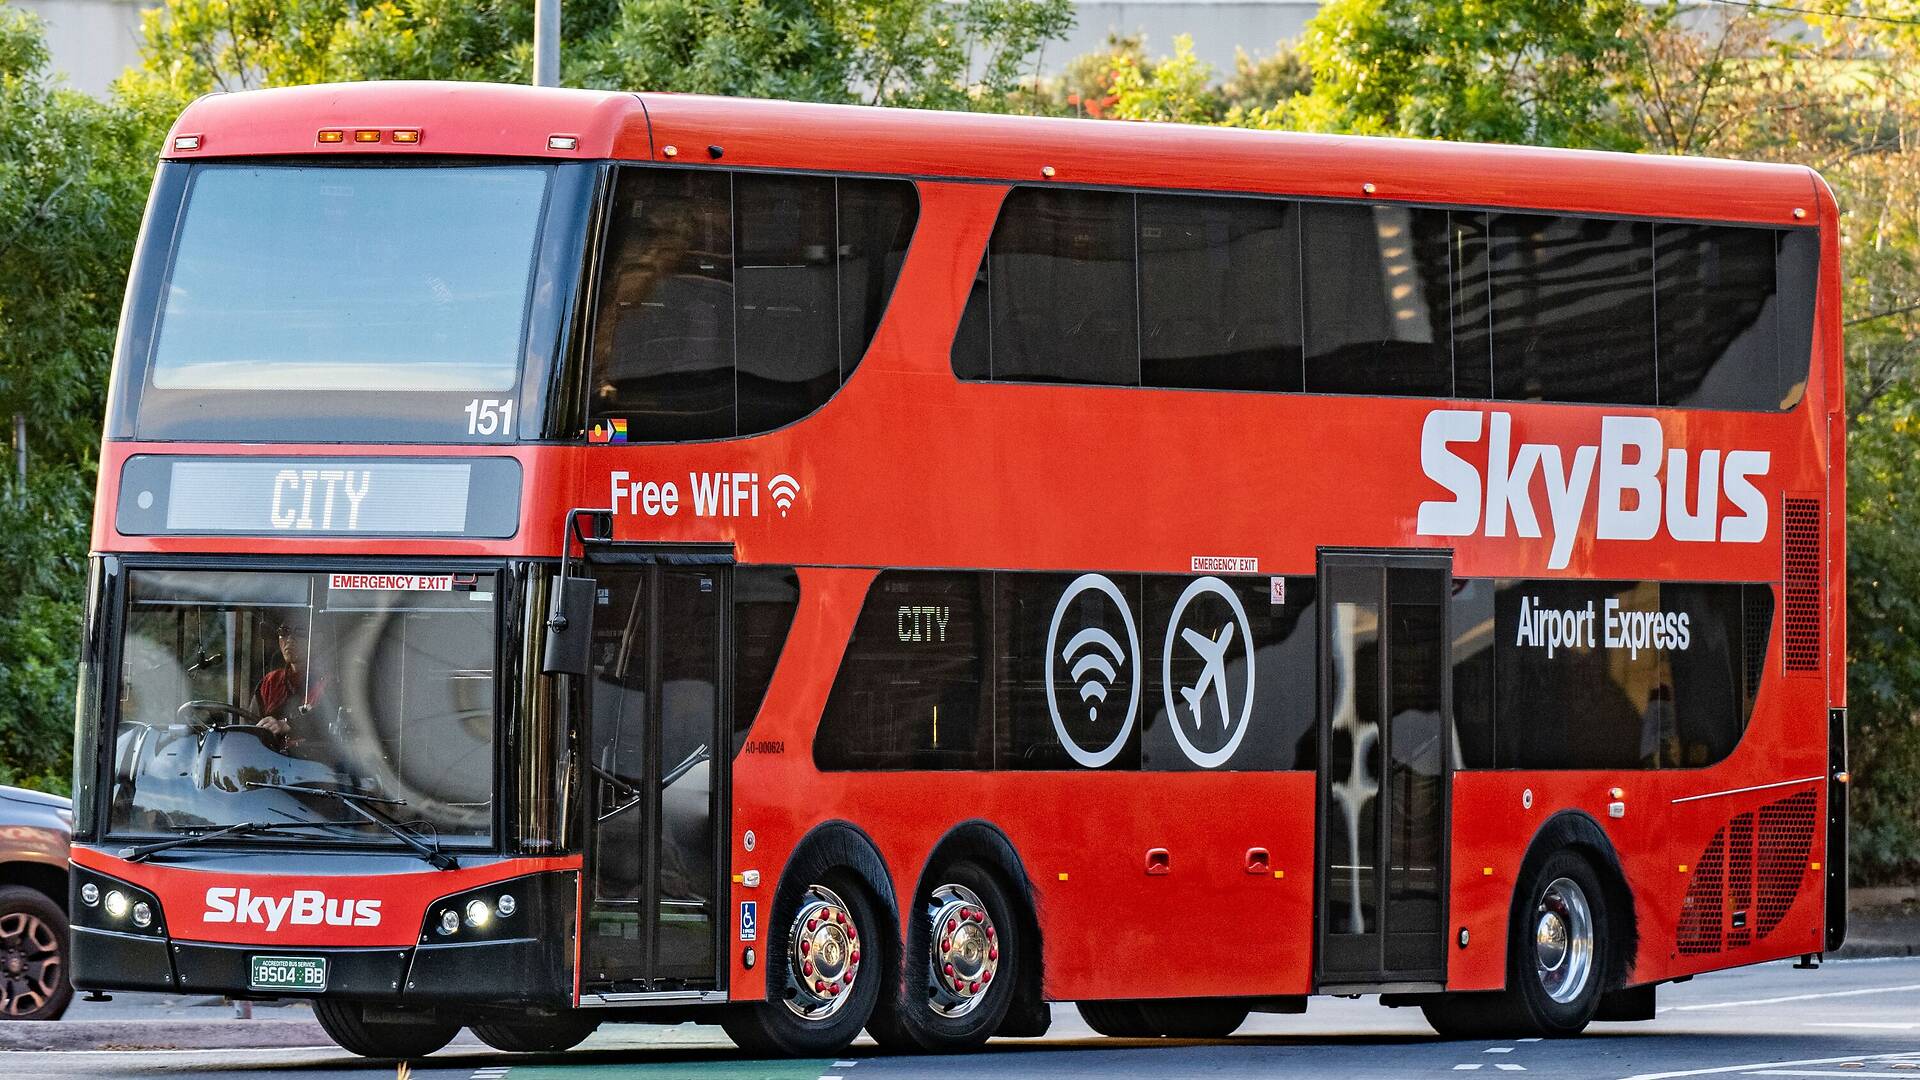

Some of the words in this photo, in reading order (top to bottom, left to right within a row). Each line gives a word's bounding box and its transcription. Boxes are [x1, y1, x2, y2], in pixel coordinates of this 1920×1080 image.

[464, 398, 513, 436] 151
[270, 470, 370, 531] CITY
[610, 471, 679, 516] Free
[689, 472, 759, 517] WiFi
[1416, 409, 1771, 570] SkyBus
[332, 575, 414, 589] EMERGENCY
[418, 576, 448, 590] EXIT
[1193, 558, 1237, 570] EMERGENCY
[1239, 559, 1256, 571] EXIT
[898, 606, 949, 642] CITY
[1516, 596, 1596, 659] Airport
[1604, 598, 1690, 661] Express
[202, 887, 382, 932] SkyBus
[304, 968, 324, 984] BB
